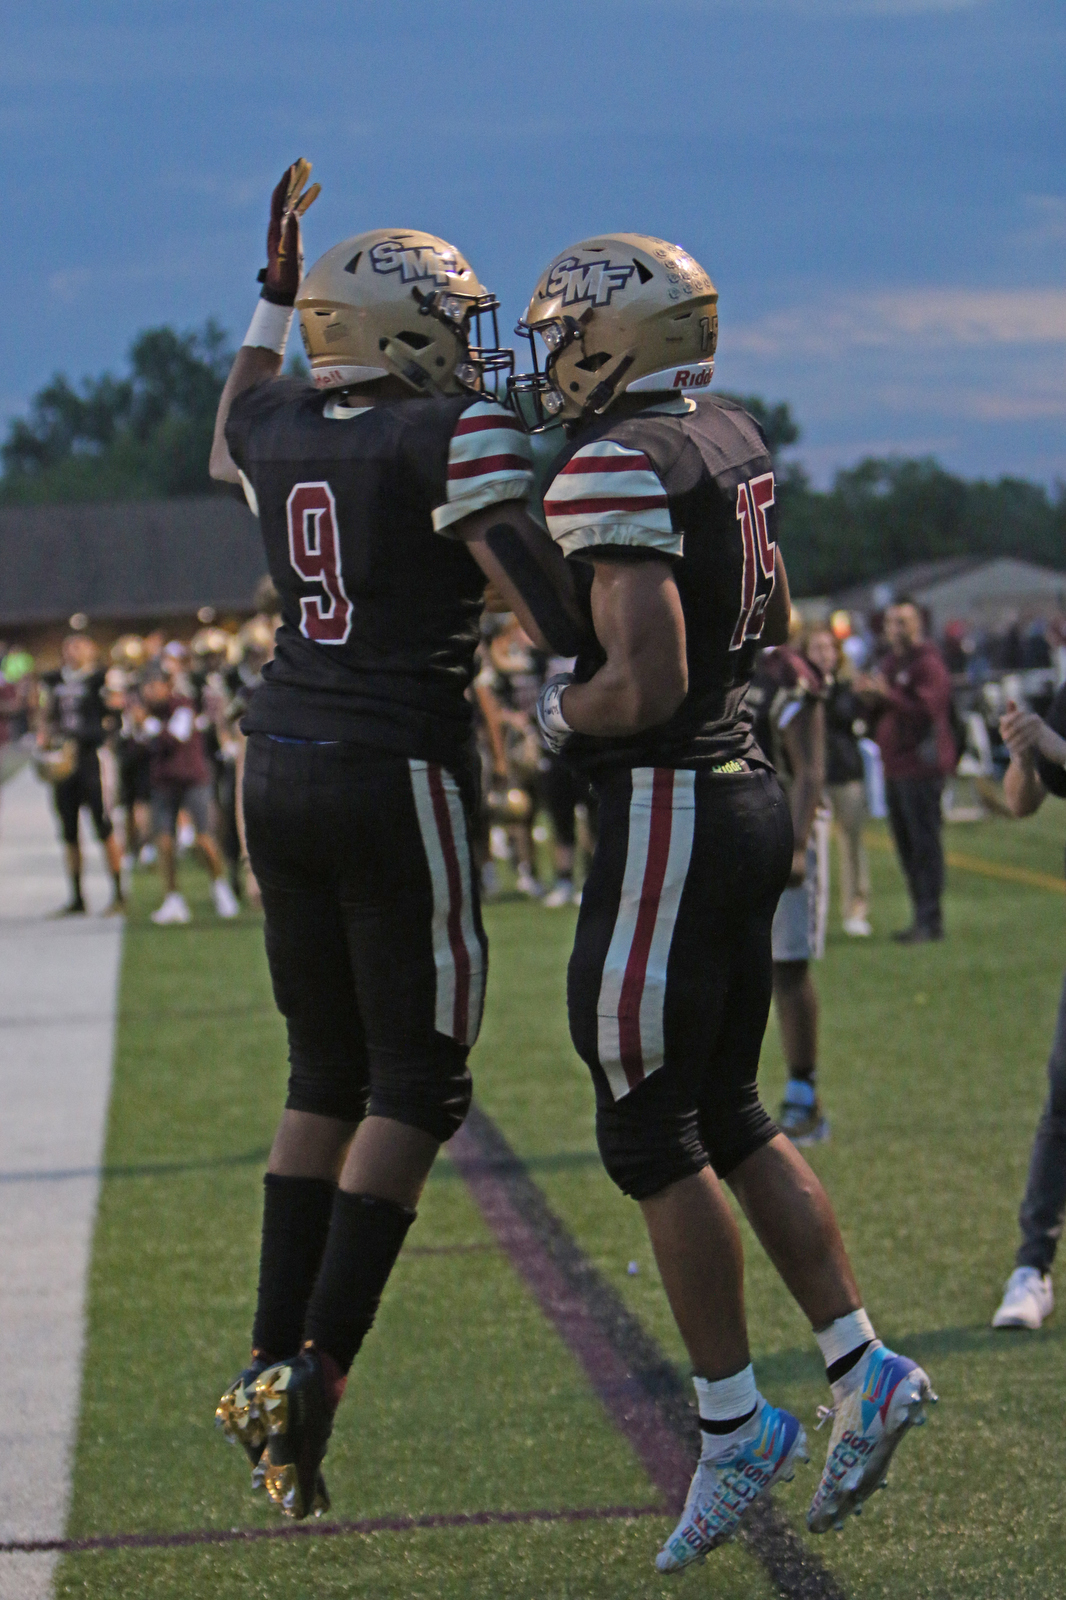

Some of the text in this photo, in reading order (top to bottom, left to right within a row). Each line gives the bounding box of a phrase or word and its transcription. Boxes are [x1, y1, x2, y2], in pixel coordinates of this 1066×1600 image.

[369, 241, 457, 286] SMF
[546, 256, 636, 308] SMF
[286, 481, 353, 645] 9
